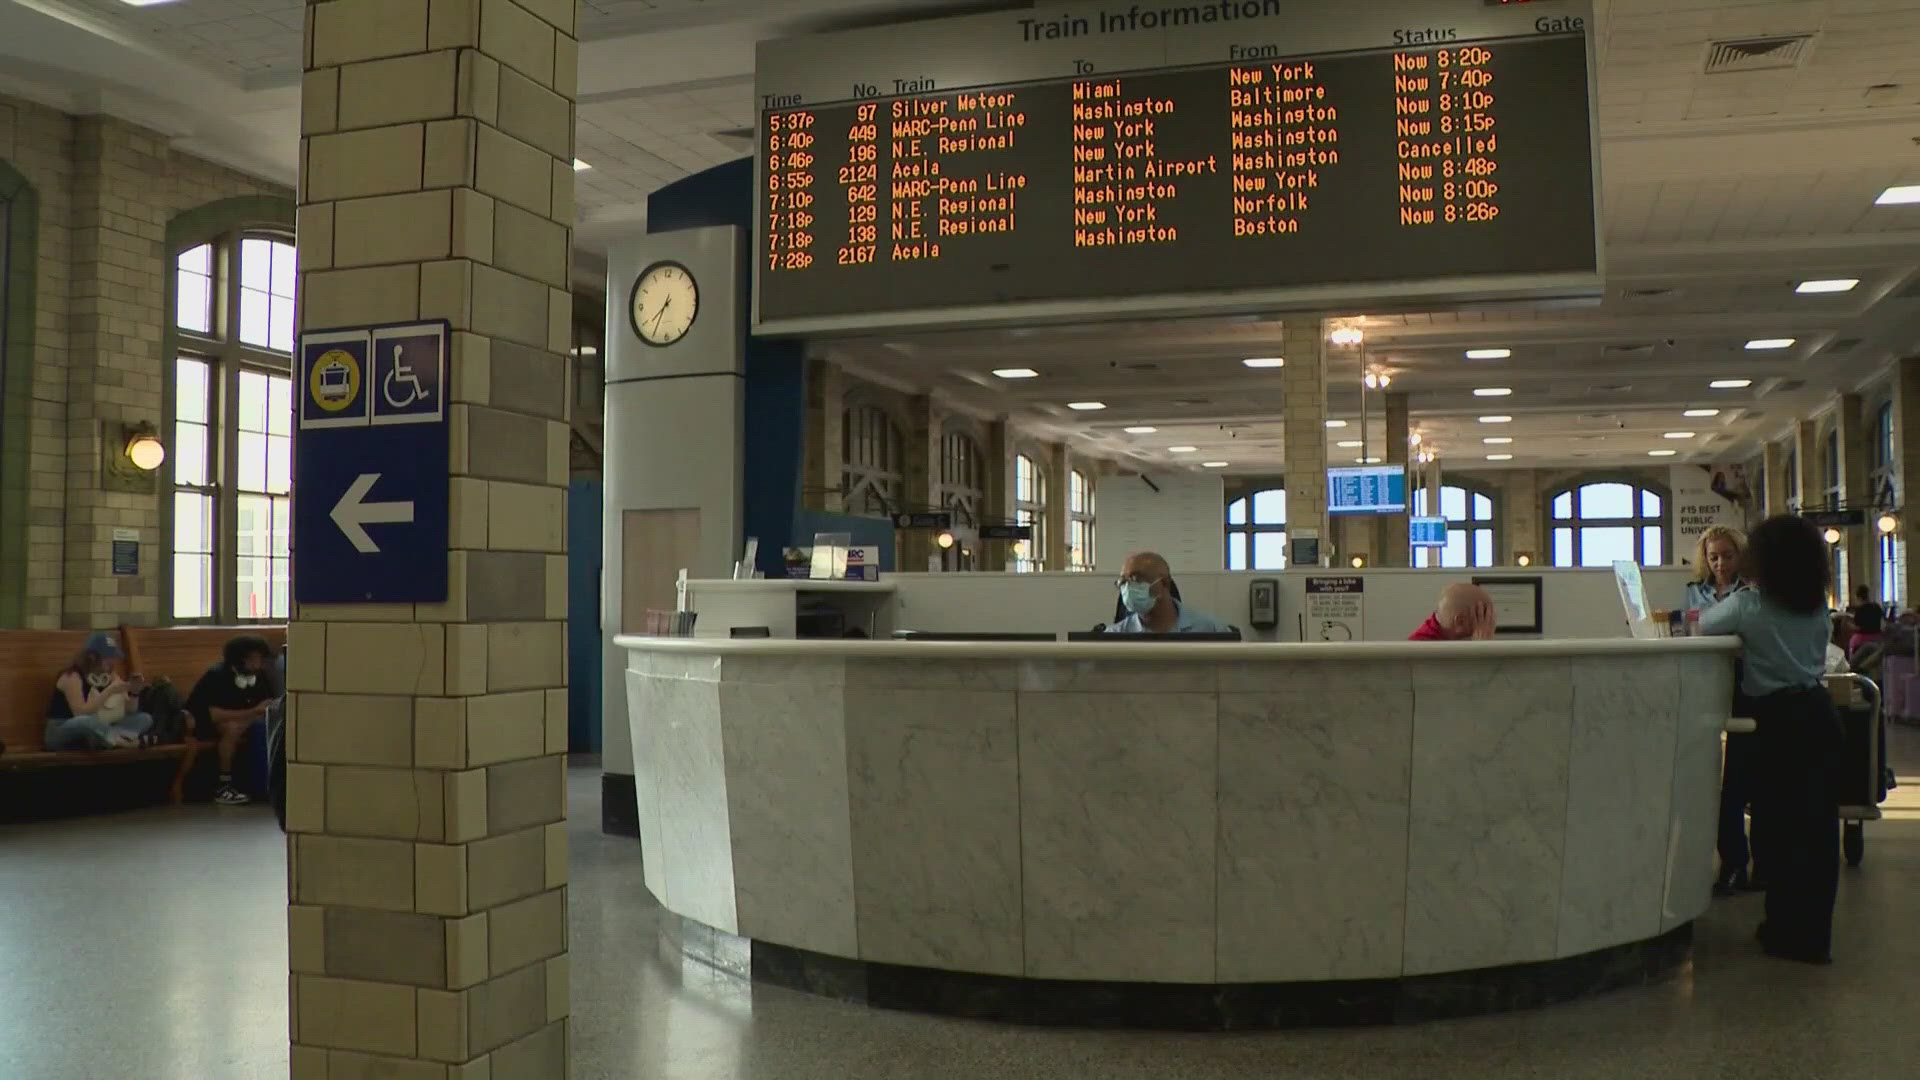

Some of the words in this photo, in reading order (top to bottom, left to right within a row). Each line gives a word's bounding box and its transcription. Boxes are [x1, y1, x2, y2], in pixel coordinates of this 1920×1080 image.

[1018, 15, 1089, 41] Train
[1099, 0, 1280, 32] Information
[763, 92, 802, 109] Time
[853, 83, 882, 98] No.
[893, 77, 935, 94] Train
[1073, 60, 1094, 74] To
[1230, 44, 1278, 60] From
[1393, 25, 1457, 46] Status
[1535, 15, 1584, 33] Gate
[770, 113, 814, 131] 5:37p
[857, 105, 876, 122] 97
[892, 99, 949, 118] Silver
[957, 92, 1015, 111] Meteor
[1073, 79, 1121, 100] Miami
[1230, 68, 1263, 85] New
[1272, 62, 1313, 81] York
[1394, 52, 1428, 71] Now
[1438, 48, 1492, 67] 8:20p
[769, 153, 814, 171] 6:46p
[849, 145, 877, 163] 196
[892, 141, 928, 158] N.E.
[939, 132, 1014, 154] Regional
[1073, 124, 1105, 142] New
[1114, 119, 1153, 138] York
[1231, 105, 1337, 127] Washington
[1396, 97, 1430, 114] Now
[1439, 92, 1494, 112] 8:10p
[770, 133, 814, 151] 6:40p
[849, 125, 877, 142] 449
[892, 117, 977, 138] MARC-Penn
[986, 111, 1025, 129] Line
[1073, 98, 1174, 119] Washington
[1231, 85, 1325, 106] Baltimore
[1395, 74, 1429, 93] Now
[1439, 70, 1492, 90] 7:40p
[769, 173, 813, 190] 6:55p
[839, 165, 877, 184] 2124
[892, 161, 939, 178] Acela
[1073, 145, 1105, 163] New
[1114, 140, 1154, 160] York
[1232, 127, 1337, 148] Washington
[1397, 118, 1431, 136] Now
[1440, 114, 1495, 134] 8:15p
[770, 193, 813, 210] 7:10p
[847, 186, 877, 203] 642
[892, 179, 977, 199] MARC-Penn
[987, 173, 1026, 190] Line
[1074, 162, 1135, 183] Martin
[1145, 154, 1216, 177] Airport
[1232, 149, 1338, 170] Washington
[1397, 135, 1497, 158] Cancelled
[770, 213, 813, 230] 7:18p
[849, 206, 877, 223] 129
[892, 202, 928, 219] N.E.
[939, 194, 1014, 215] Regional
[1074, 183, 1176, 203] Washington
[1233, 175, 1266, 192] New
[1277, 170, 1317, 189] York
[1399, 162, 1433, 181] Now
[1442, 159, 1497, 179] 8:48p
[770, 233, 813, 250] 7:18p
[849, 226, 877, 243] 138
[892, 223, 928, 240] N.E.
[939, 214, 1014, 235] Regional
[1074, 208, 1106, 225] New
[1115, 204, 1155, 222] York
[1233, 194, 1307, 215] Norfolk
[1399, 185, 1434, 203] Now
[1443, 181, 1498, 201] 8:00p
[770, 253, 813, 270] 7:28p
[838, 246, 876, 264] 2167
[892, 243, 939, 260] Acela
[1075, 225, 1177, 246] Washington
[1234, 218, 1298, 236] Boston
[1400, 207, 1435, 225] Now
[1444, 203, 1499, 223] 8:26p
[1680, 516, 1713, 525] PUBLIC
[1699, 504, 1721, 514] BEST
